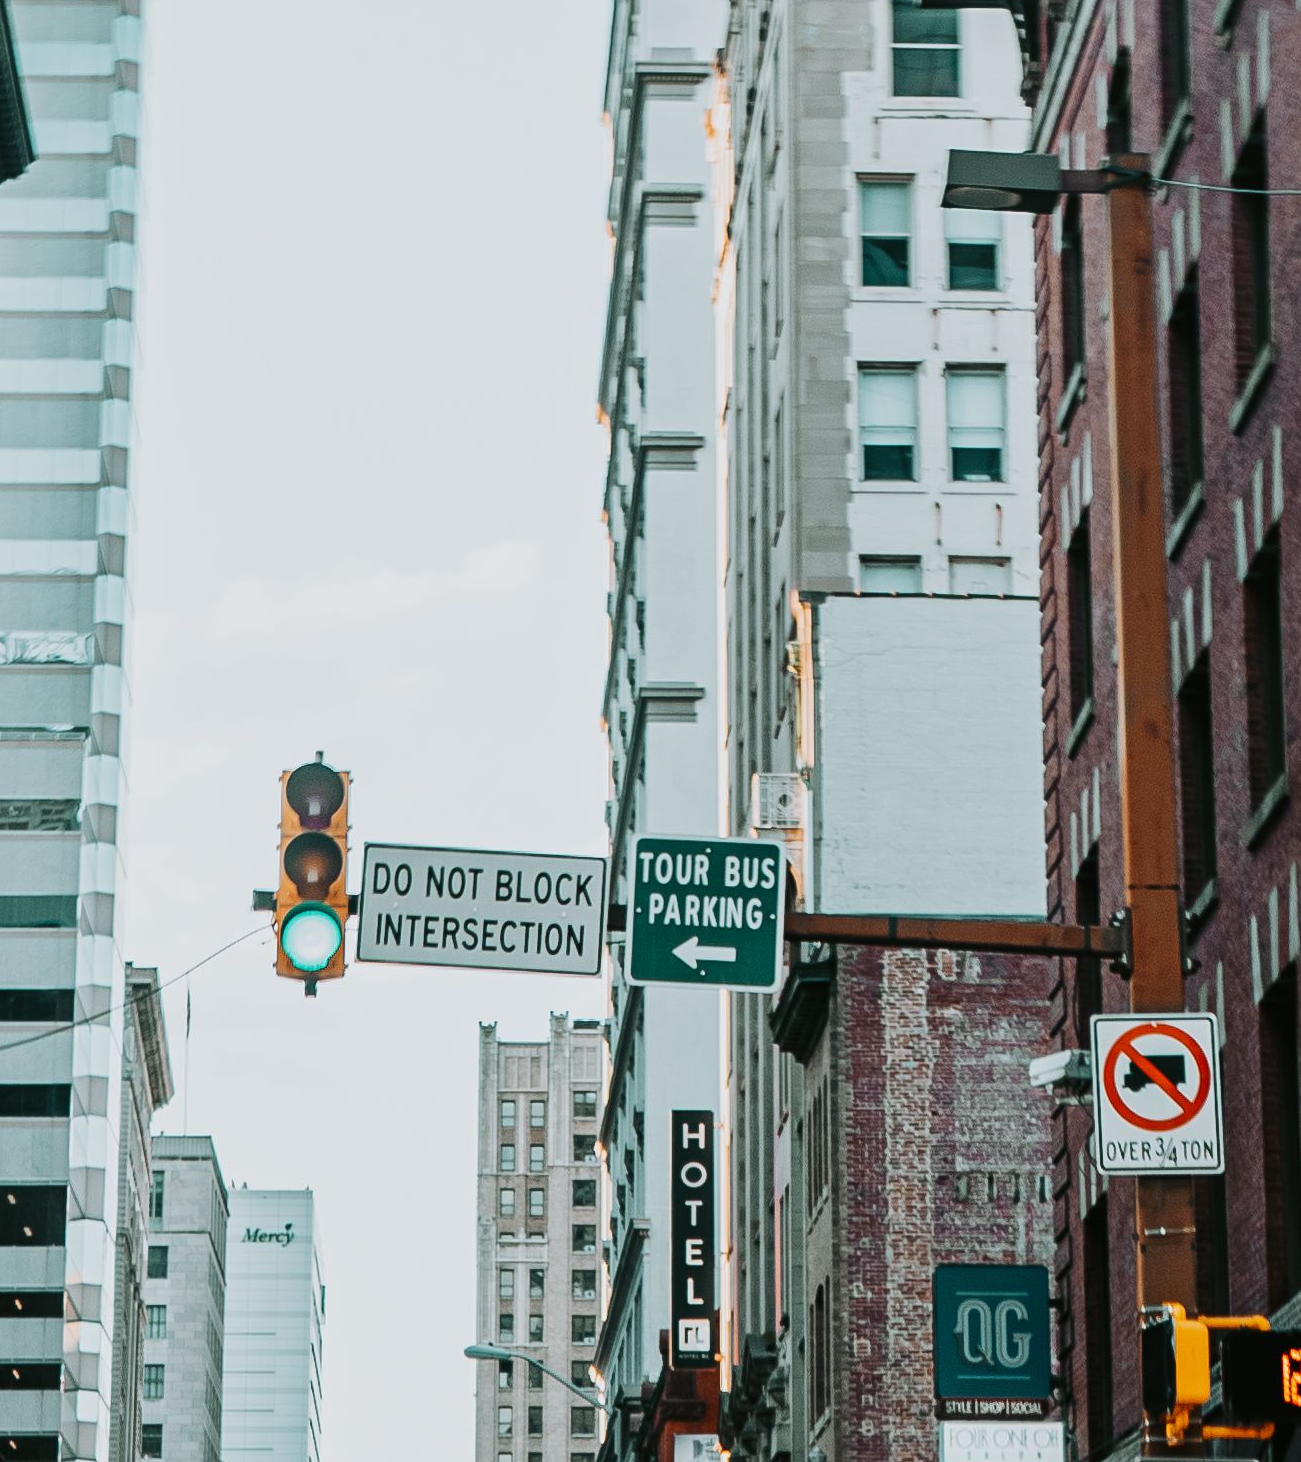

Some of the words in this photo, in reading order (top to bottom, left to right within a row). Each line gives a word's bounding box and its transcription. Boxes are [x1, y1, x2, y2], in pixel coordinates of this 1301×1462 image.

[372, 862, 412, 896] DO
[426, 865, 484, 901] NOT
[495, 869, 593, 907] BLOCK
[639, 851, 709, 887] TOUR
[724, 856, 776, 889] BUS
[648, 892, 763, 930] PARKING
[375, 912, 584, 957] INTERSECTION
[1107, 1141, 1151, 1161] OVER
[1181, 1140, 1214, 1160] TON
[681, 1123, 707, 1305] HOTEL
[241, 1227, 295, 1248] Mercy
[954, 1299, 1032, 1368] QG
[946, 1401, 972, 1414] STYLE
[980, 1401, 1005, 1414] SHOP
[1011, 1401, 1042, 1414] SOCIAL
